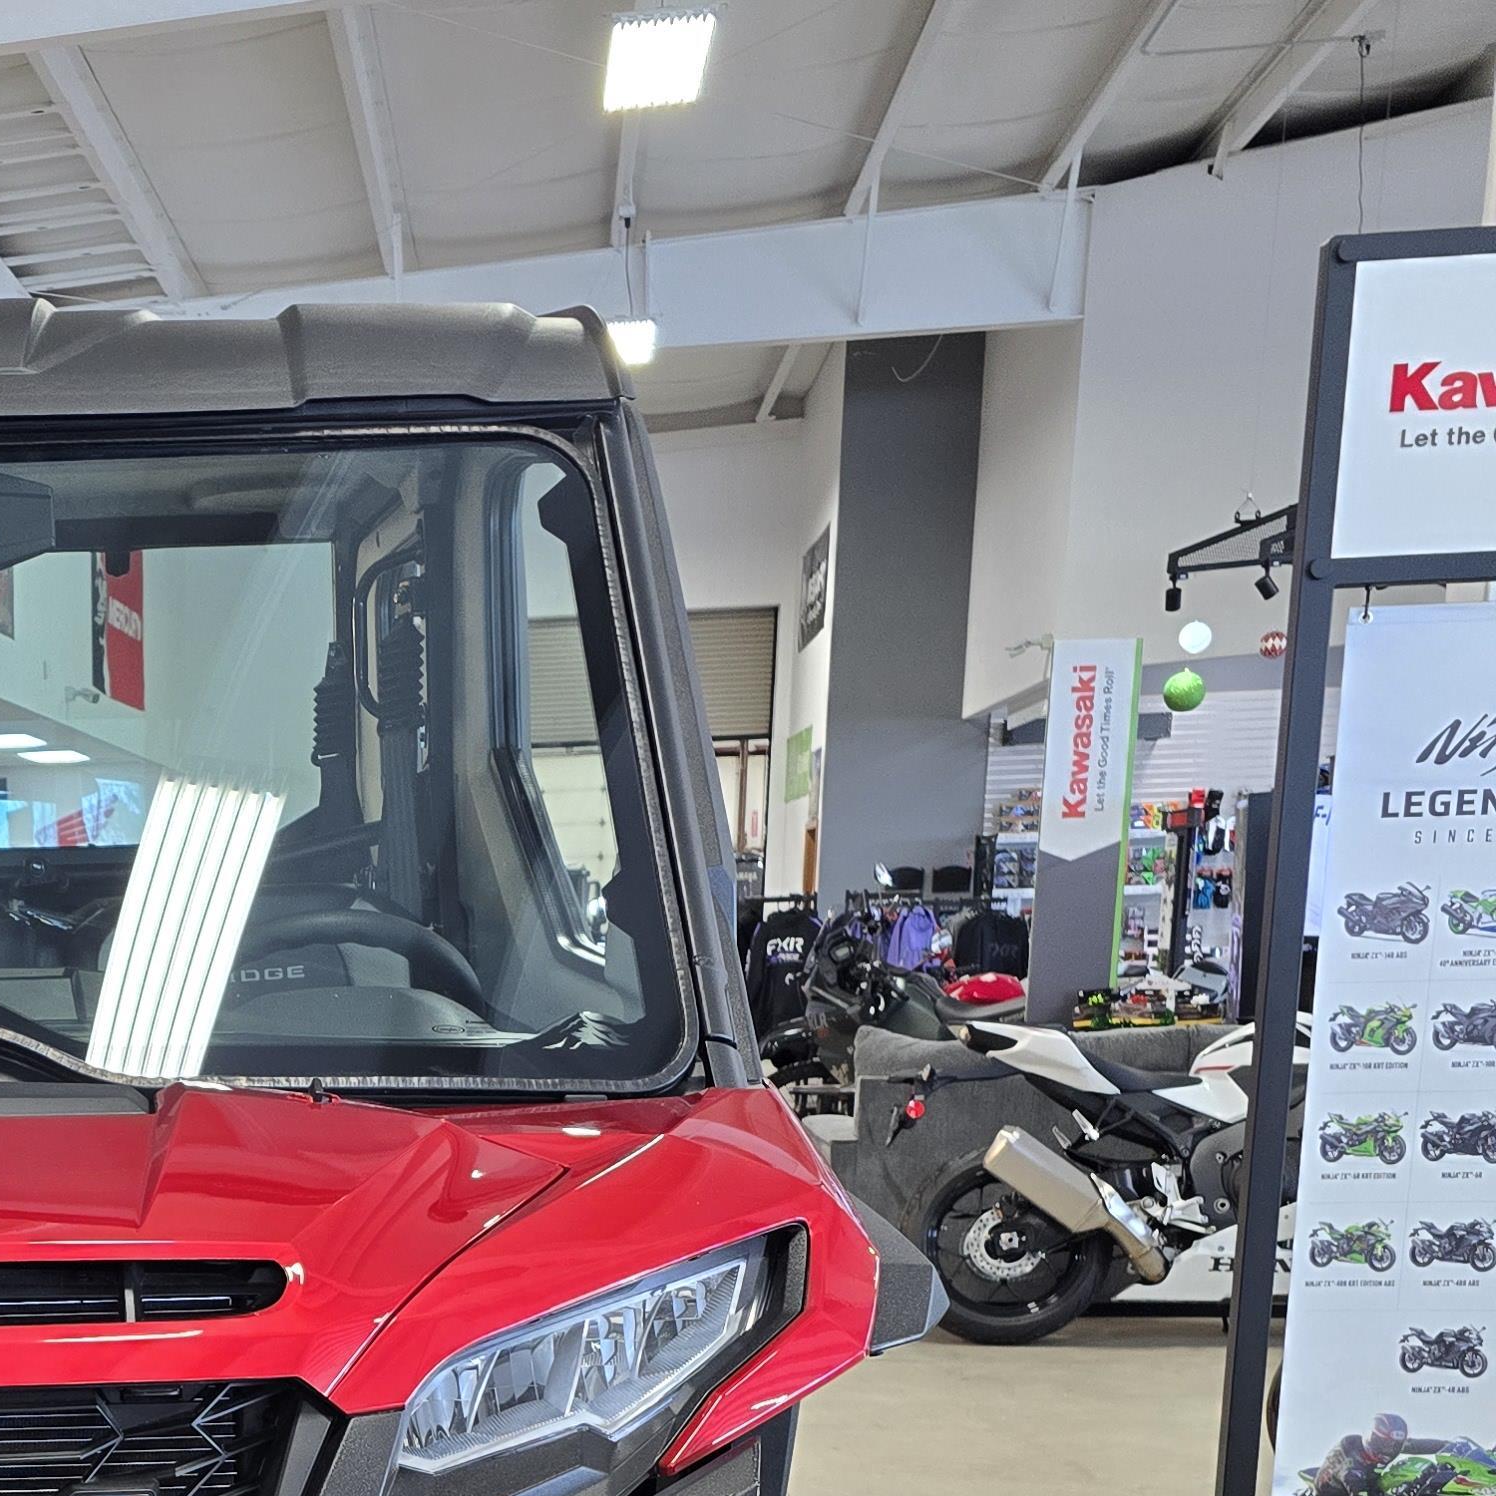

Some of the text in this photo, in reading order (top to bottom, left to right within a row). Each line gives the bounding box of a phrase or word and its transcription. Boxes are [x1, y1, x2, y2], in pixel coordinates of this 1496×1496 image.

[1400, 426, 1486, 448] Let the
[1100, 697, 1113, 733] Times
[1062, 664, 1097, 819] Kawasaki
[1097, 736, 1110, 768] Good
[1095, 770, 1106, 790] the
[1094, 793, 1105, 812] Let
[1414, 828, 1494, 844] SINCE
[766, 936, 804, 956] FXR
